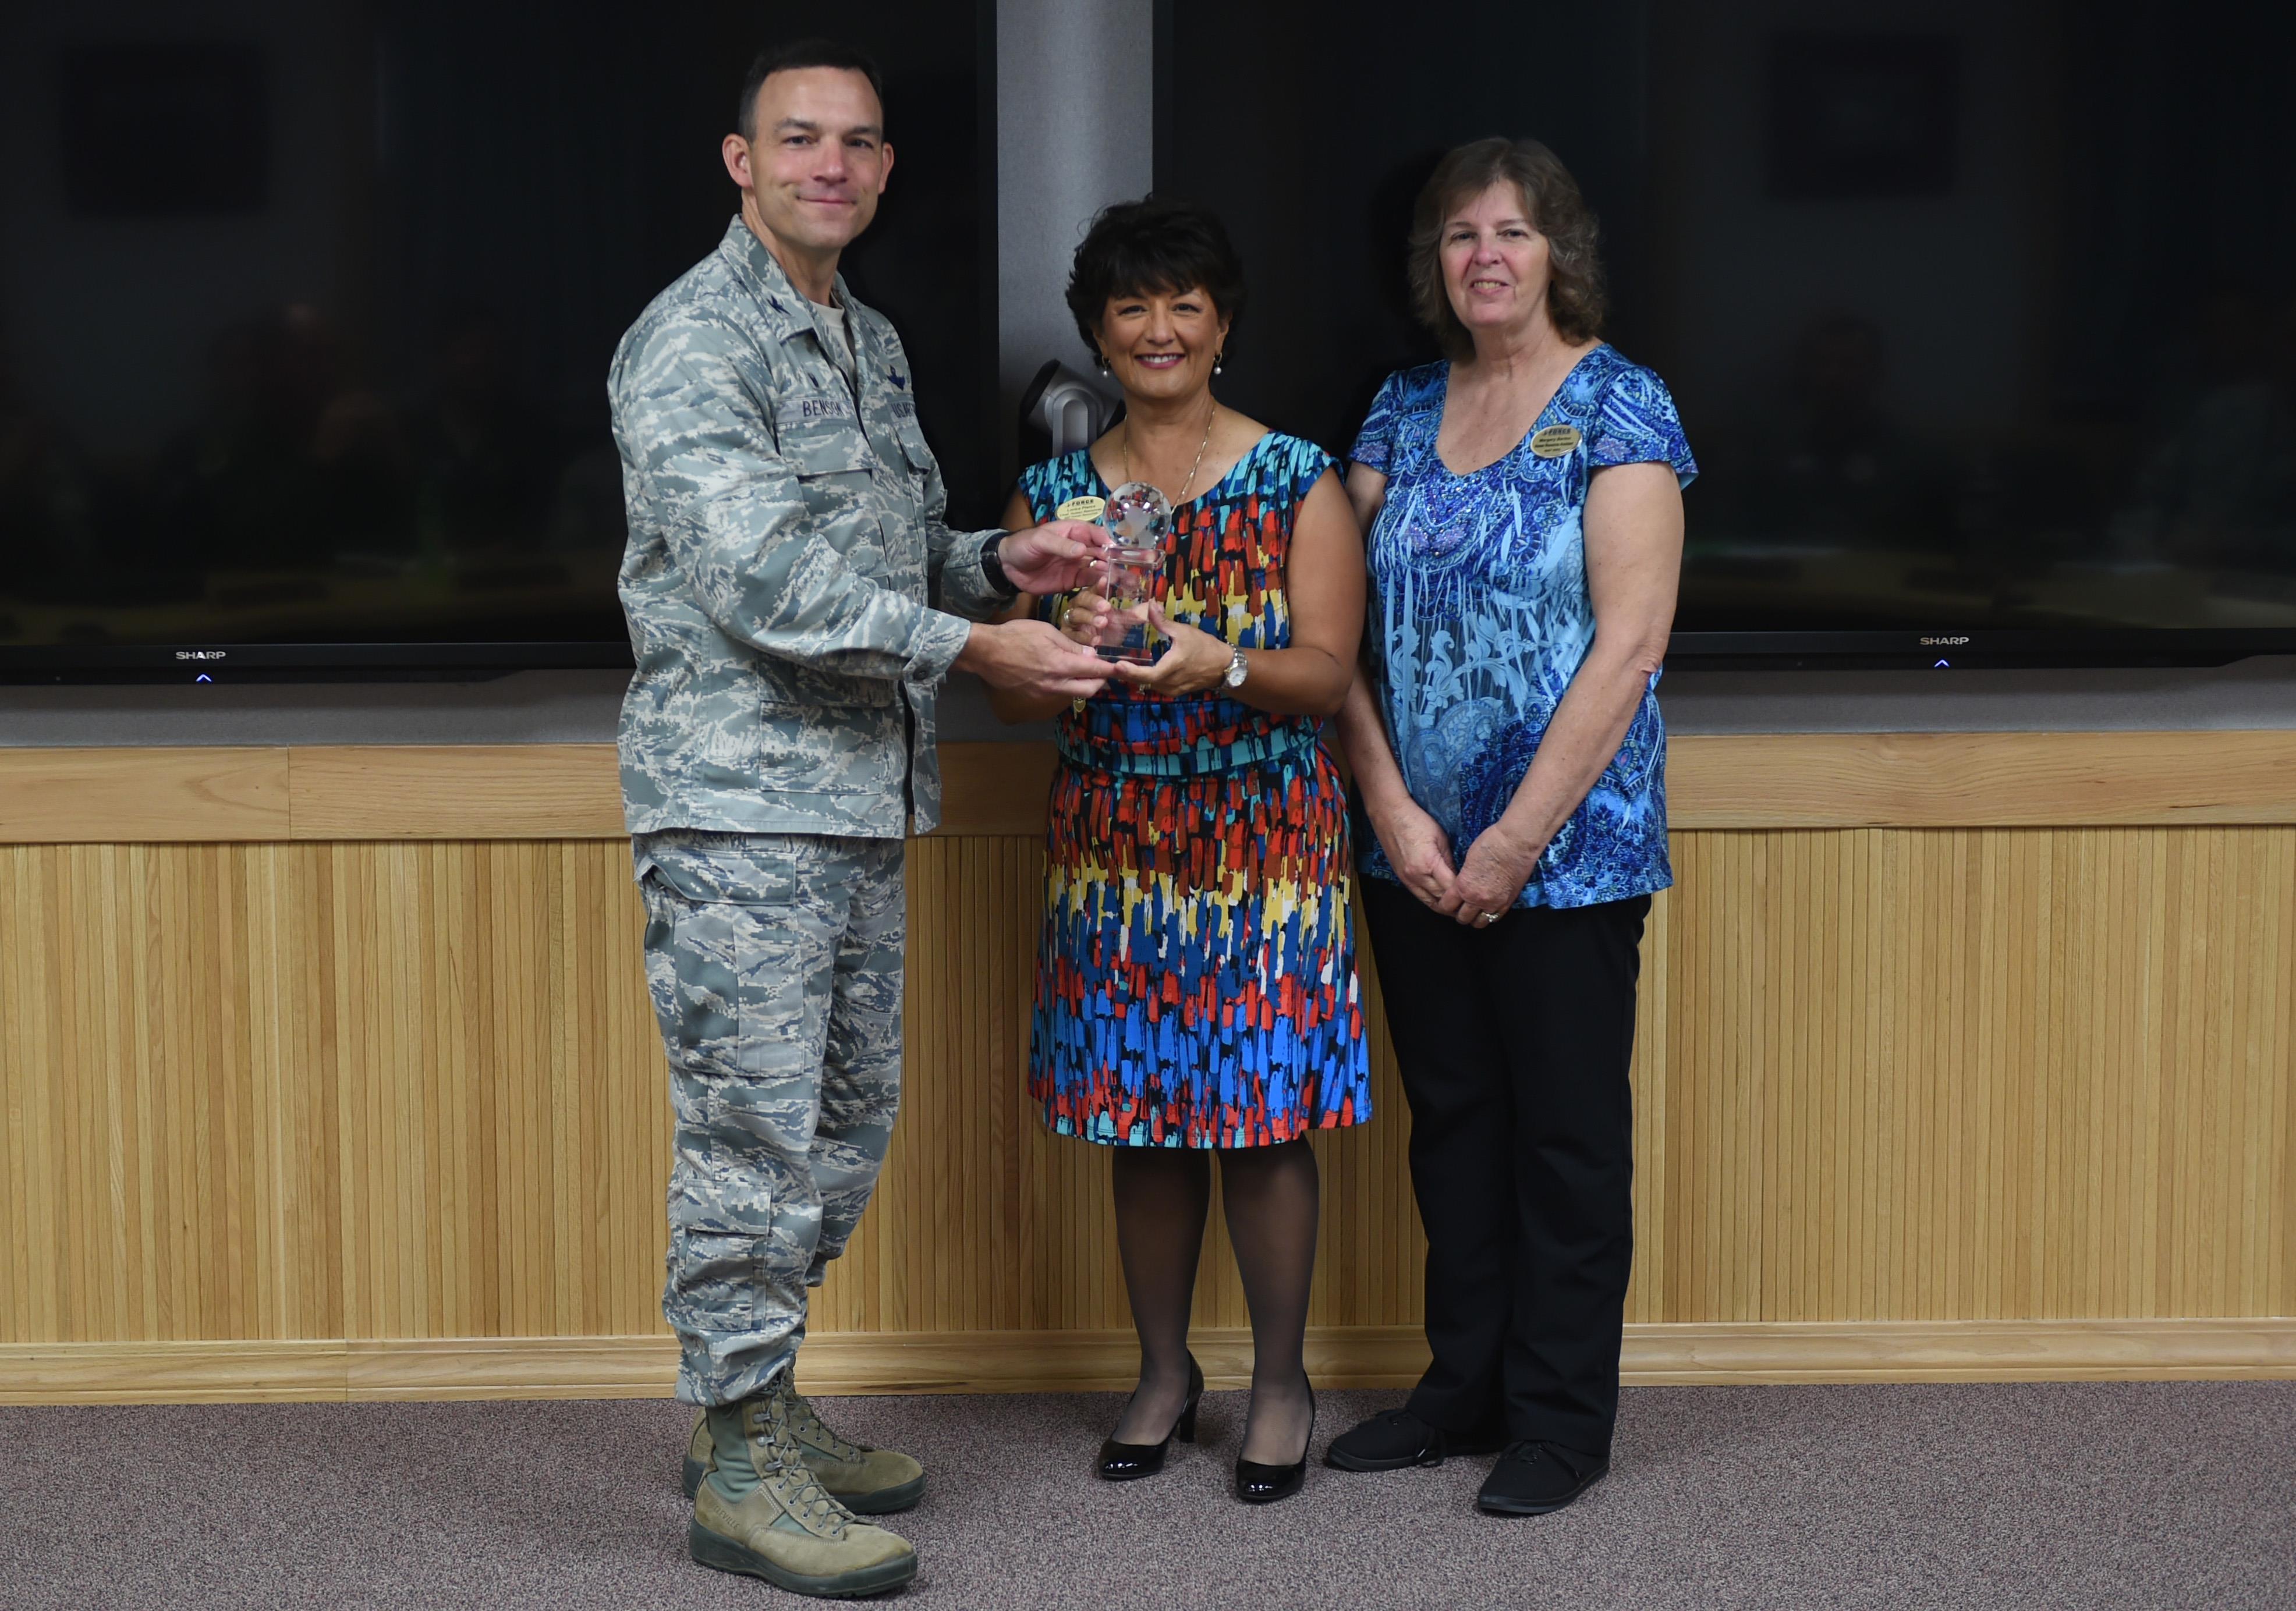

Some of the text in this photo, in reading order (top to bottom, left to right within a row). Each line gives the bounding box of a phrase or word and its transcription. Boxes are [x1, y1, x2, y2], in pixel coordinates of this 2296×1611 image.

[803, 399, 844, 417] BENSON
[1919, 637, 1969, 645] SHARP
[176, 651, 226, 659] SHARP
